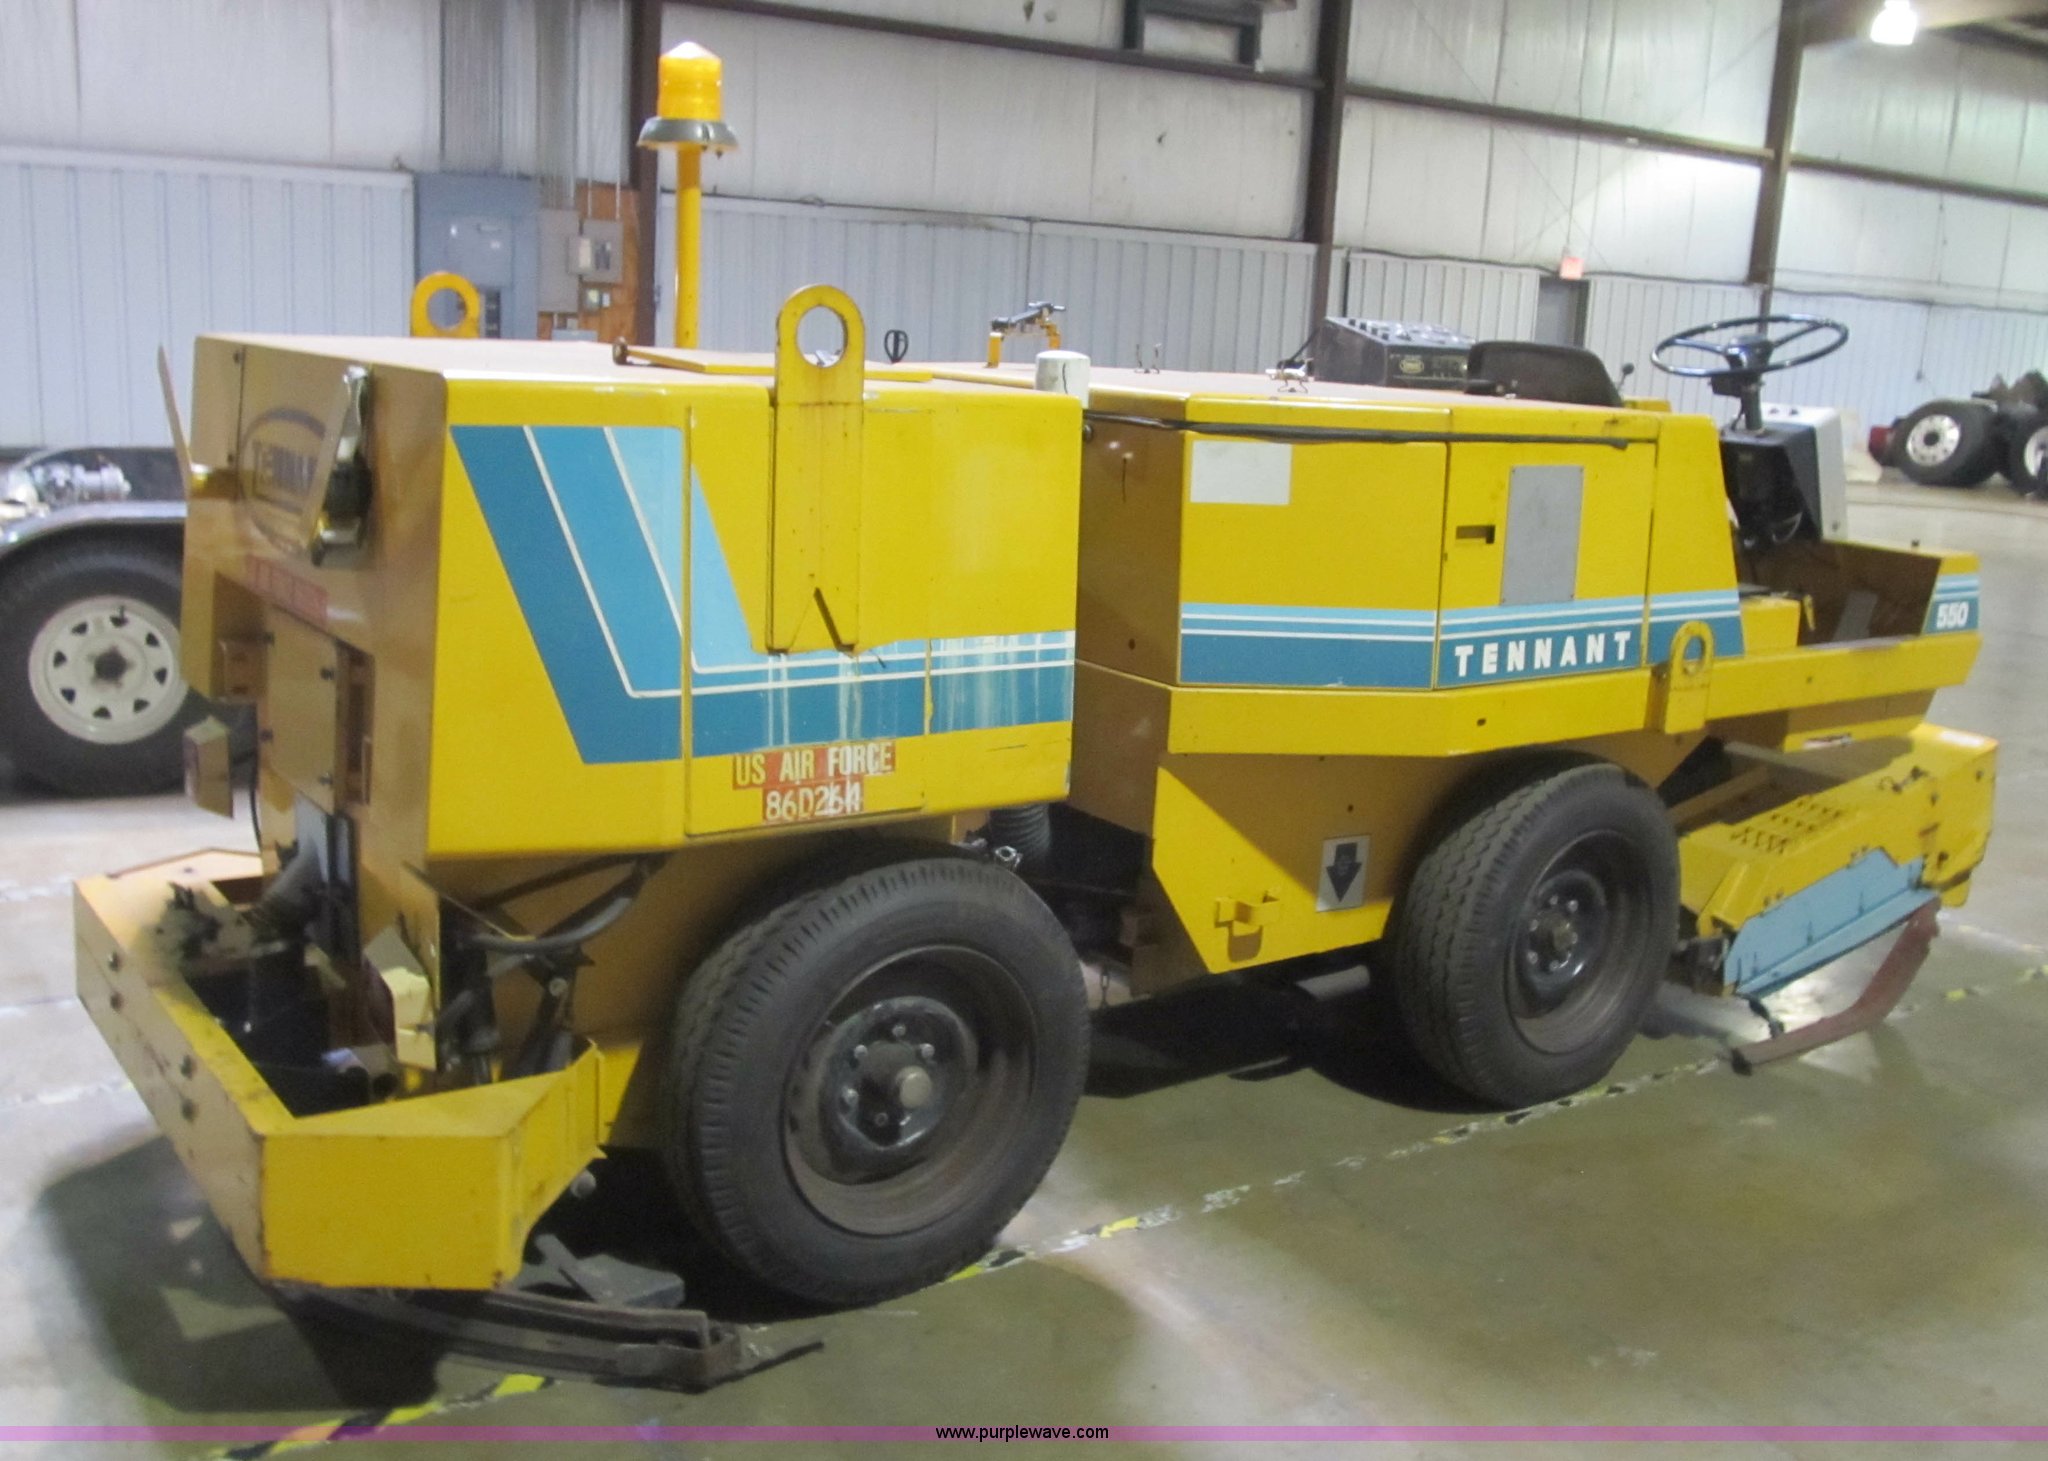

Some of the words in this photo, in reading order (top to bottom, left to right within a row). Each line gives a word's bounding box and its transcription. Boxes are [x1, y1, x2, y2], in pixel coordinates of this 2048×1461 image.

[1936, 600, 1969, 629] 550
[1455, 631, 1632, 677] TENNANT
[736, 754, 765, 785] US
[780, 749, 814, 781] AIR
[829, 743, 891, 776] FORCE
